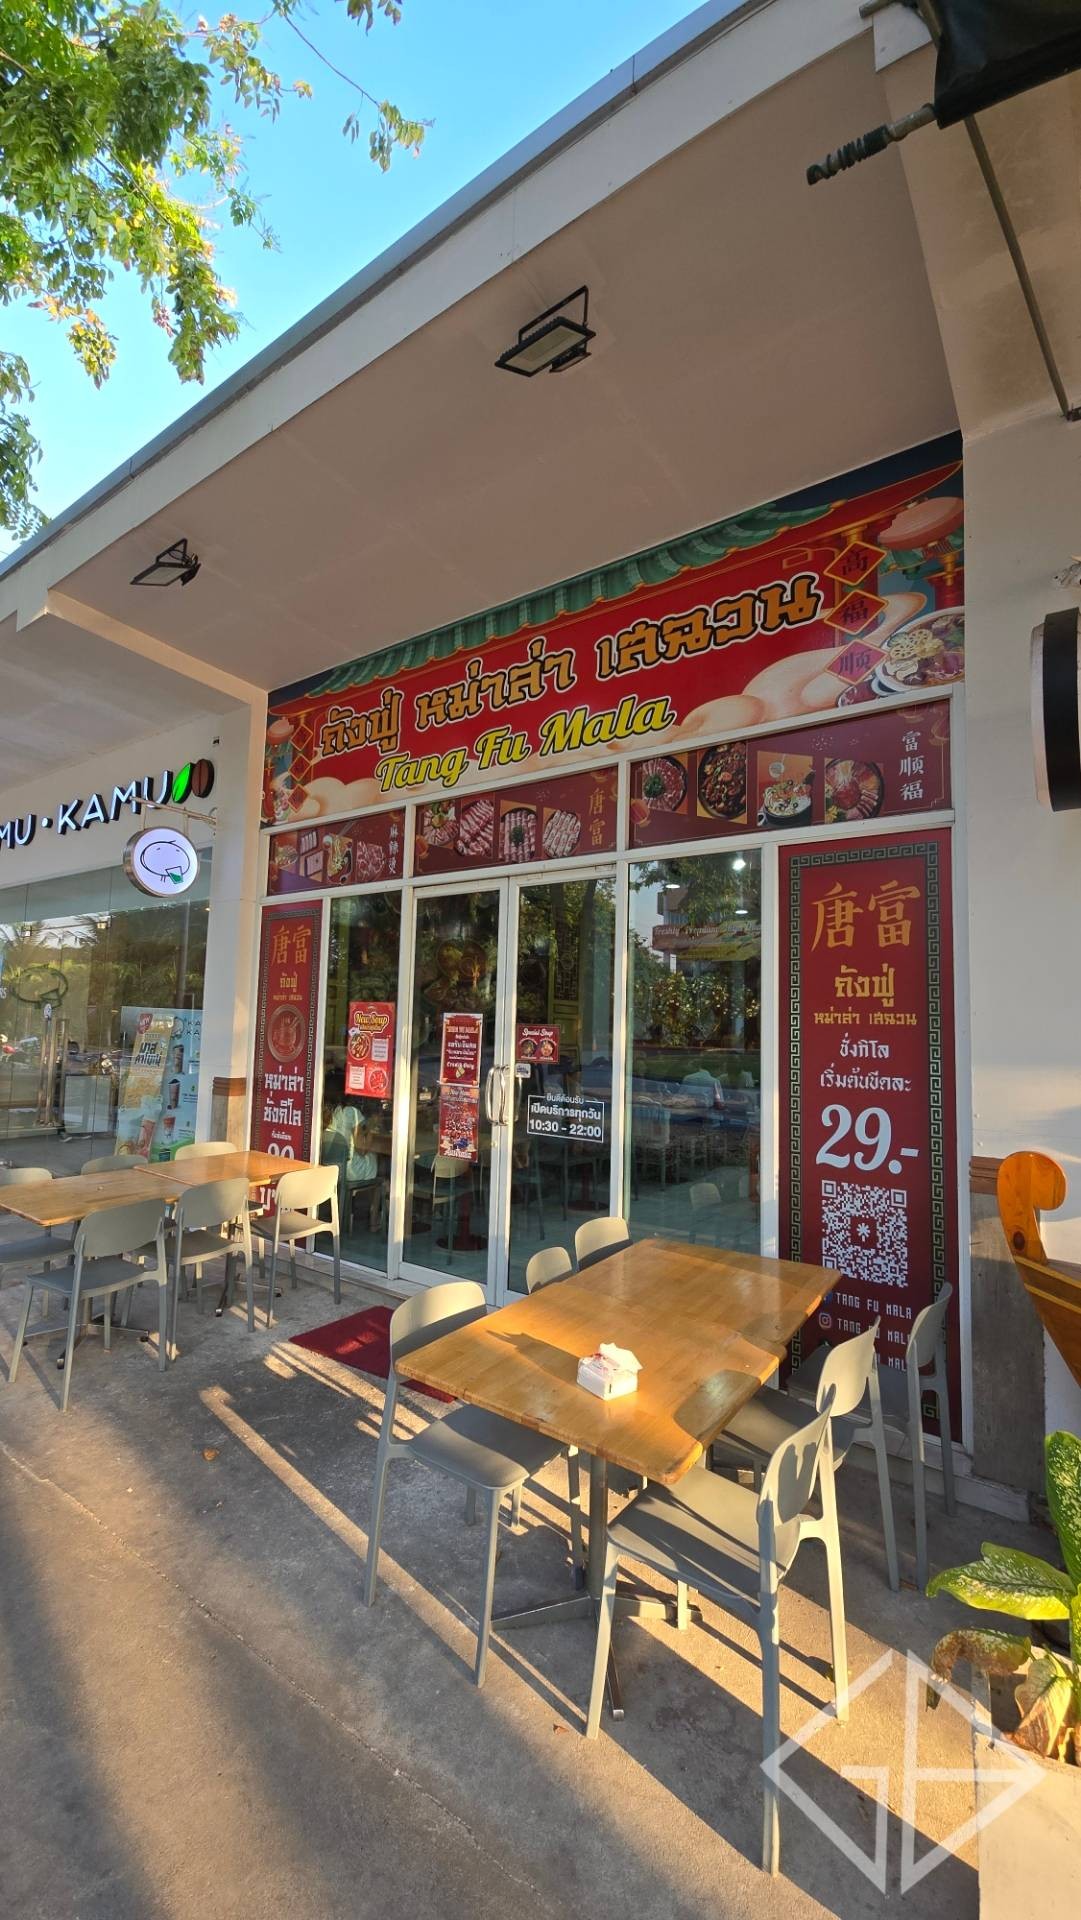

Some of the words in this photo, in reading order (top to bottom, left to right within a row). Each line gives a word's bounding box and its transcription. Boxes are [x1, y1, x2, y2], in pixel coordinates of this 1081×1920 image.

[415, 639, 576, 730] หม่าล่า
[597, 573, 823, 680] เสฉวน
[375, 746, 468, 792] Tang
[476, 725, 530, 770] Fu
[540, 695, 676, 756] Mala
[57, 770, 174, 834] KAMU
[810, 879, 921, 952] 唐富
[271, 924, 311, 966] 唐富
[814, 1006, 860, 1025] หม่าล่า
[869, 1011, 918, 1026] เสฉวน
[839, 1032, 890, 1059] ชั่งกิโล
[264, 1065, 304, 1093] หม่าล่า
[820, 1063, 912, 1092] เริ่มต้นขีดละ
[530, 1102, 601, 1122] เปิดบริการทุกวัน
[529, 1119, 559, 1132] 10:30
[569, 1123, 601, 1137] 22:00
[815, 1104, 920, 1174] 29.-
[835, 1292, 860, 1309] TANG
[867, 1299, 879, 1312] FU
[886, 1303, 912, 1320] MALA
[837, 1318, 861, 1334] TANG
